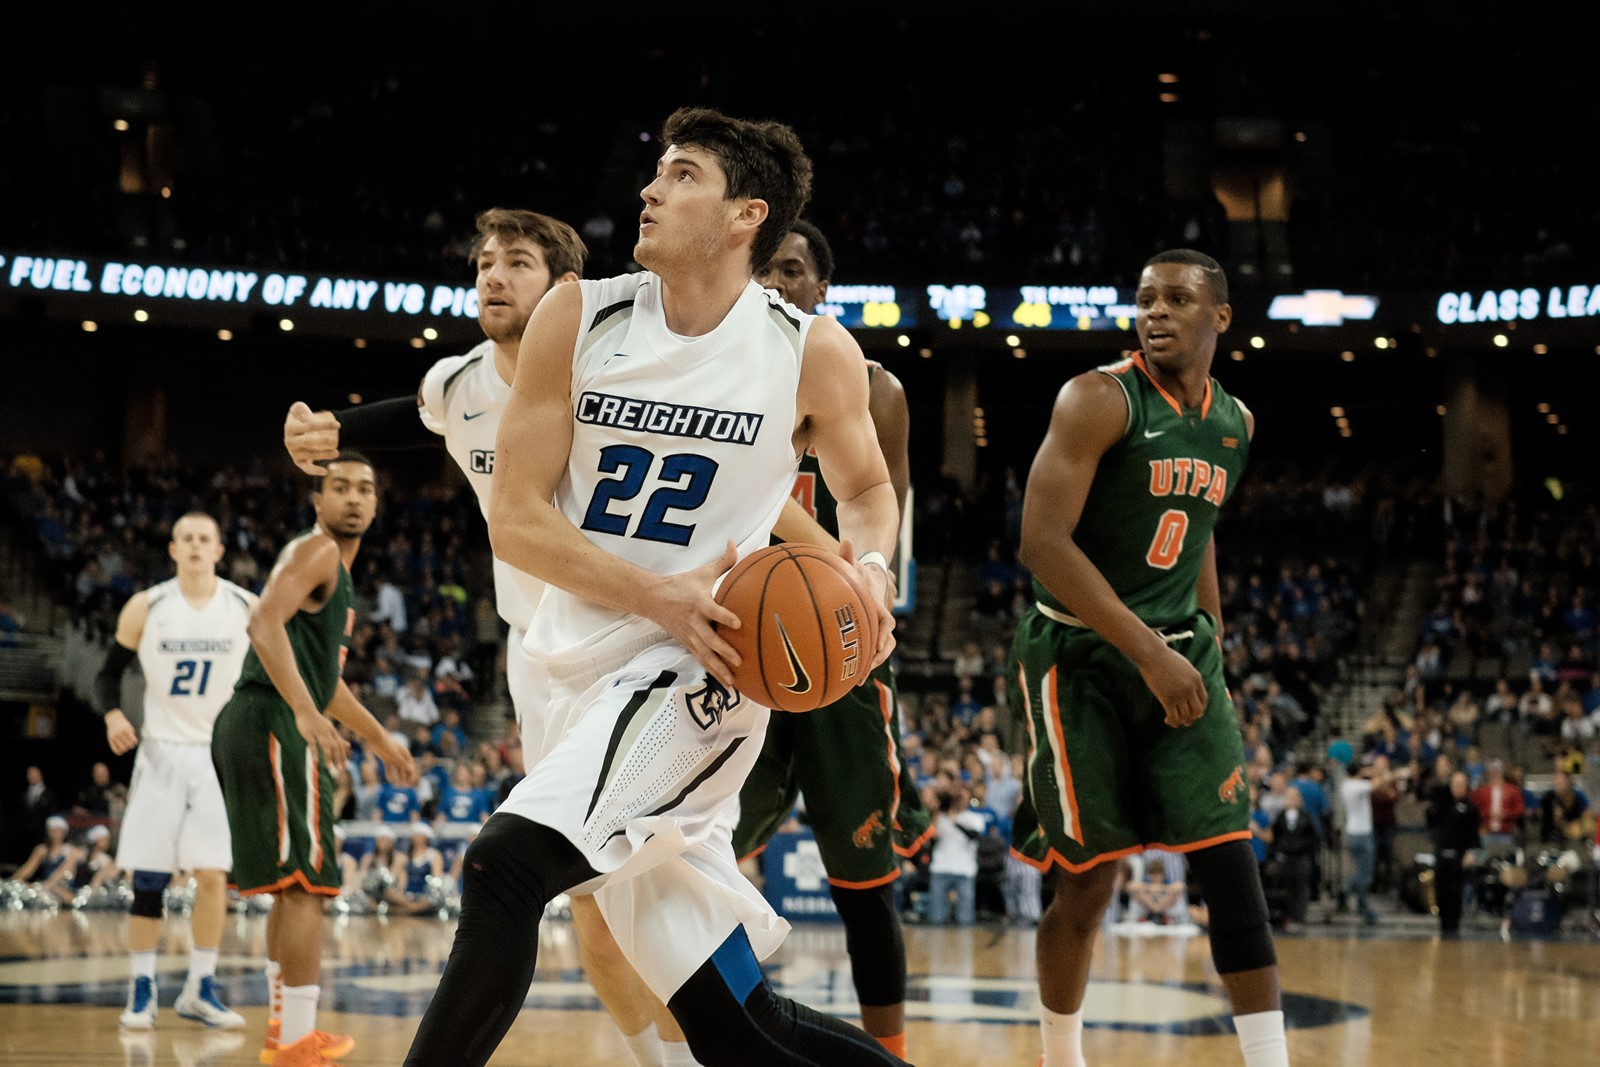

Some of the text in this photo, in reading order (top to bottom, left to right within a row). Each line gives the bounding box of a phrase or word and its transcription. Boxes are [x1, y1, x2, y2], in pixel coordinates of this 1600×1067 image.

[10, 256, 92, 292] FUEL
[101, 262, 257, 302] ECONOMY
[262, 273, 307, 305] OF
[310, 278, 378, 311] ANY
[1437, 287, 1540, 324] CLASS
[576, 391, 763, 446] CREIGHTON
[580, 444, 719, 546] 22
[1149, 457, 1227, 507] UTPA
[1146, 509, 1189, 570] 0
[170, 660, 212, 696] 21
